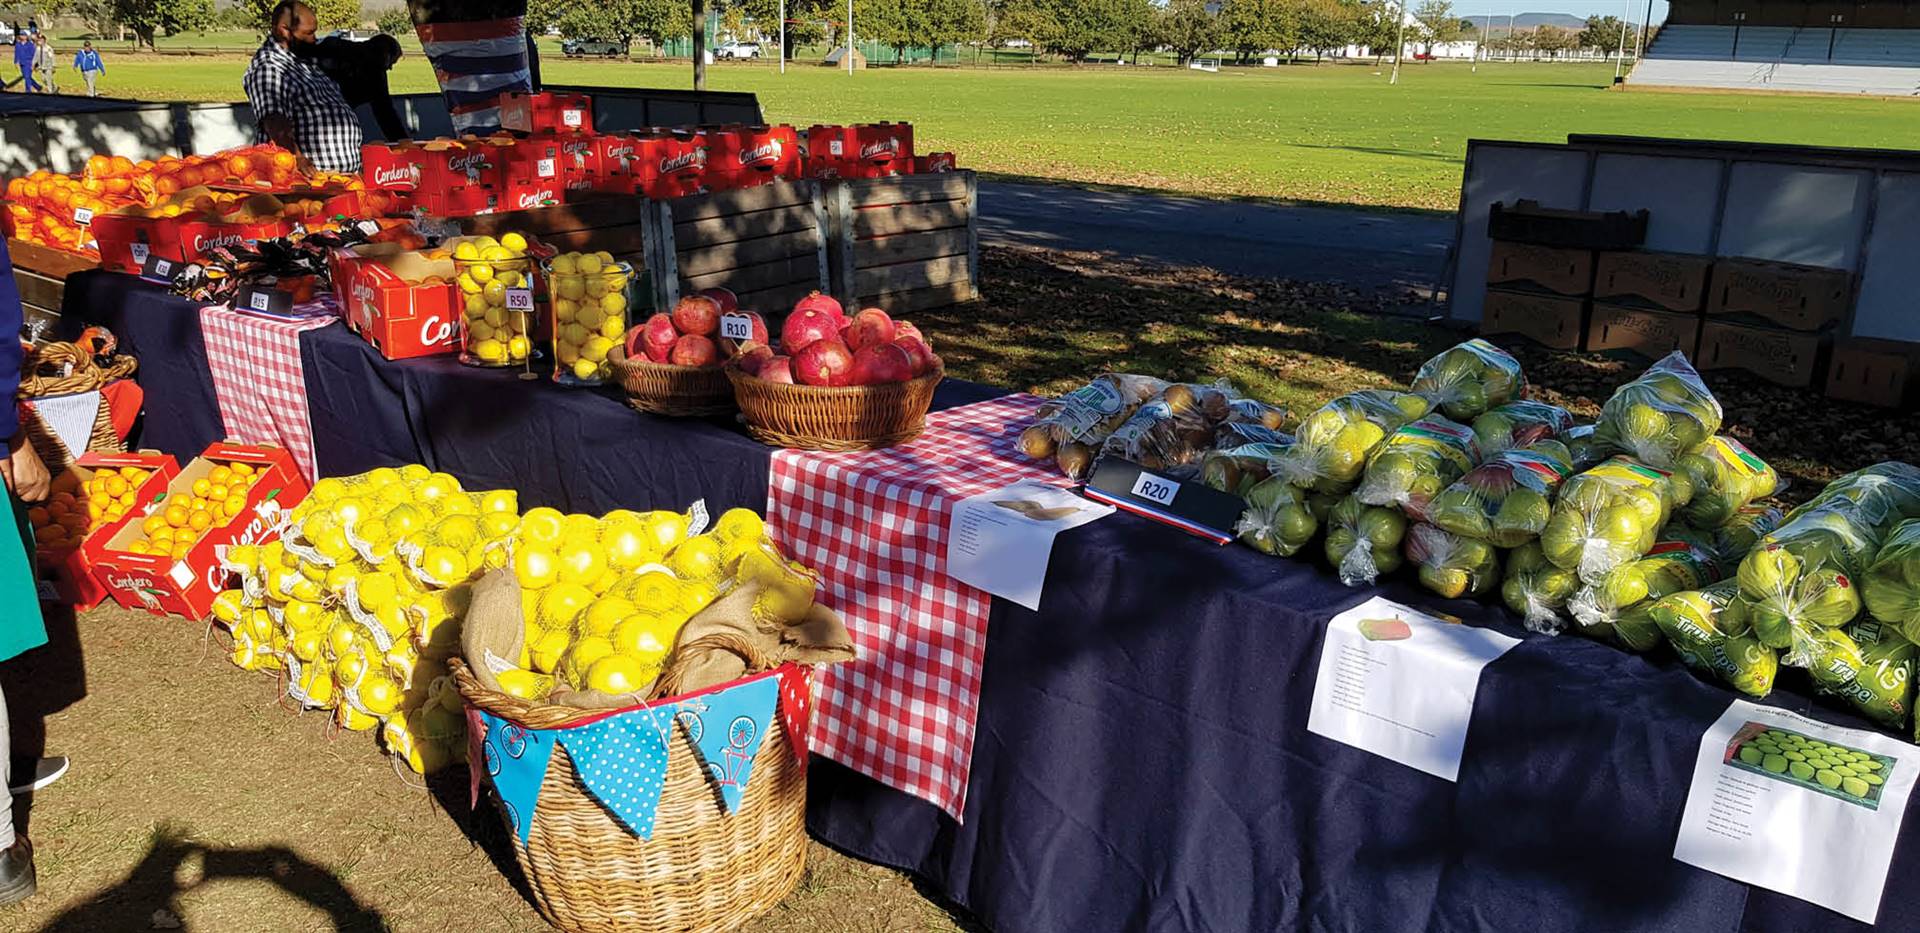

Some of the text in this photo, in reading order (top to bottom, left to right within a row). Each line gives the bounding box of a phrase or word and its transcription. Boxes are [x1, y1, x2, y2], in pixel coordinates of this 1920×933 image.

[607, 143, 634, 158] Cordero
[739, 143, 772, 165] Cordero
[447, 152, 485, 171] Cordero
[660, 150, 696, 173] Cordero
[374, 163, 409, 185] Cordero
[519, 188, 553, 208] Cordero
[510, 296, 528, 307] R50
[726, 322, 747, 337] R10
[1139, 480, 1170, 500] R20
[107, 573, 153, 589] Cordero
